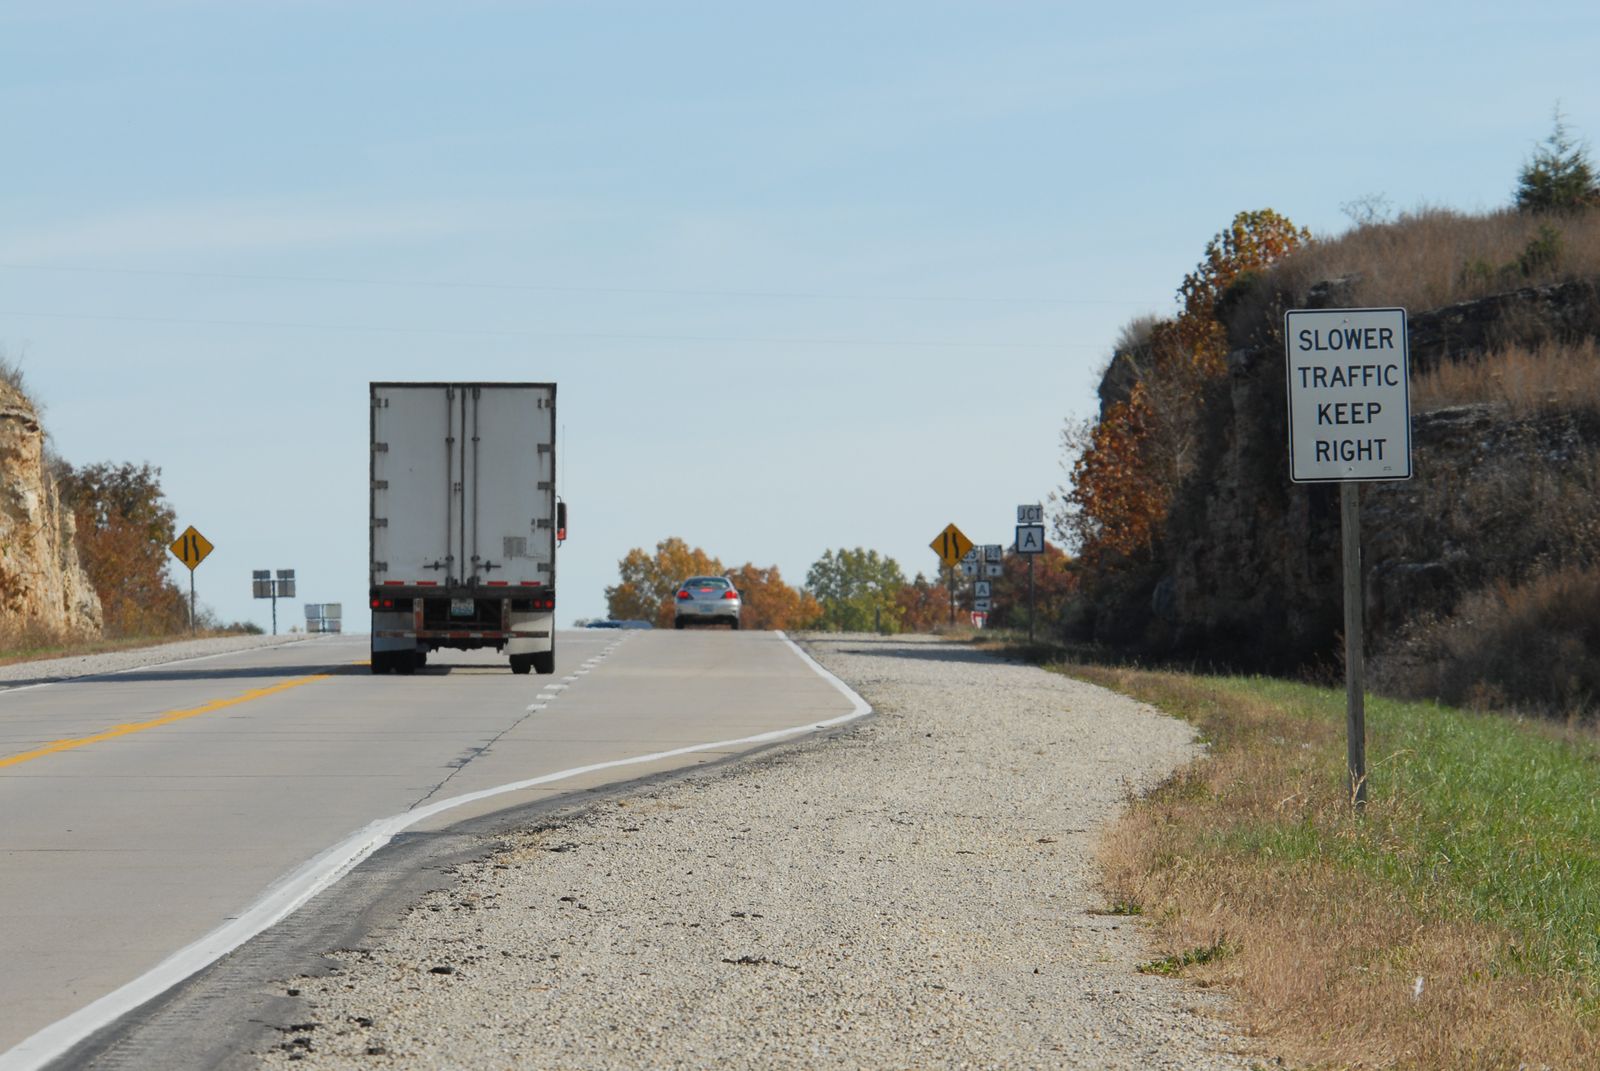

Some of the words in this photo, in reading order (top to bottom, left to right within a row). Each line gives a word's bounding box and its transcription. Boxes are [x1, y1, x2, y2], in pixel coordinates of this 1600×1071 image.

[1299, 328, 1394, 351] SLOWER
[1297, 364, 1399, 388] TRAFFIC
[1317, 402, 1382, 425] KEEP
[1315, 439, 1387, 462] RIGHT
[1019, 507, 1041, 520] JCT
[1024, 531, 1037, 547] A
[977, 584, 987, 594] A
